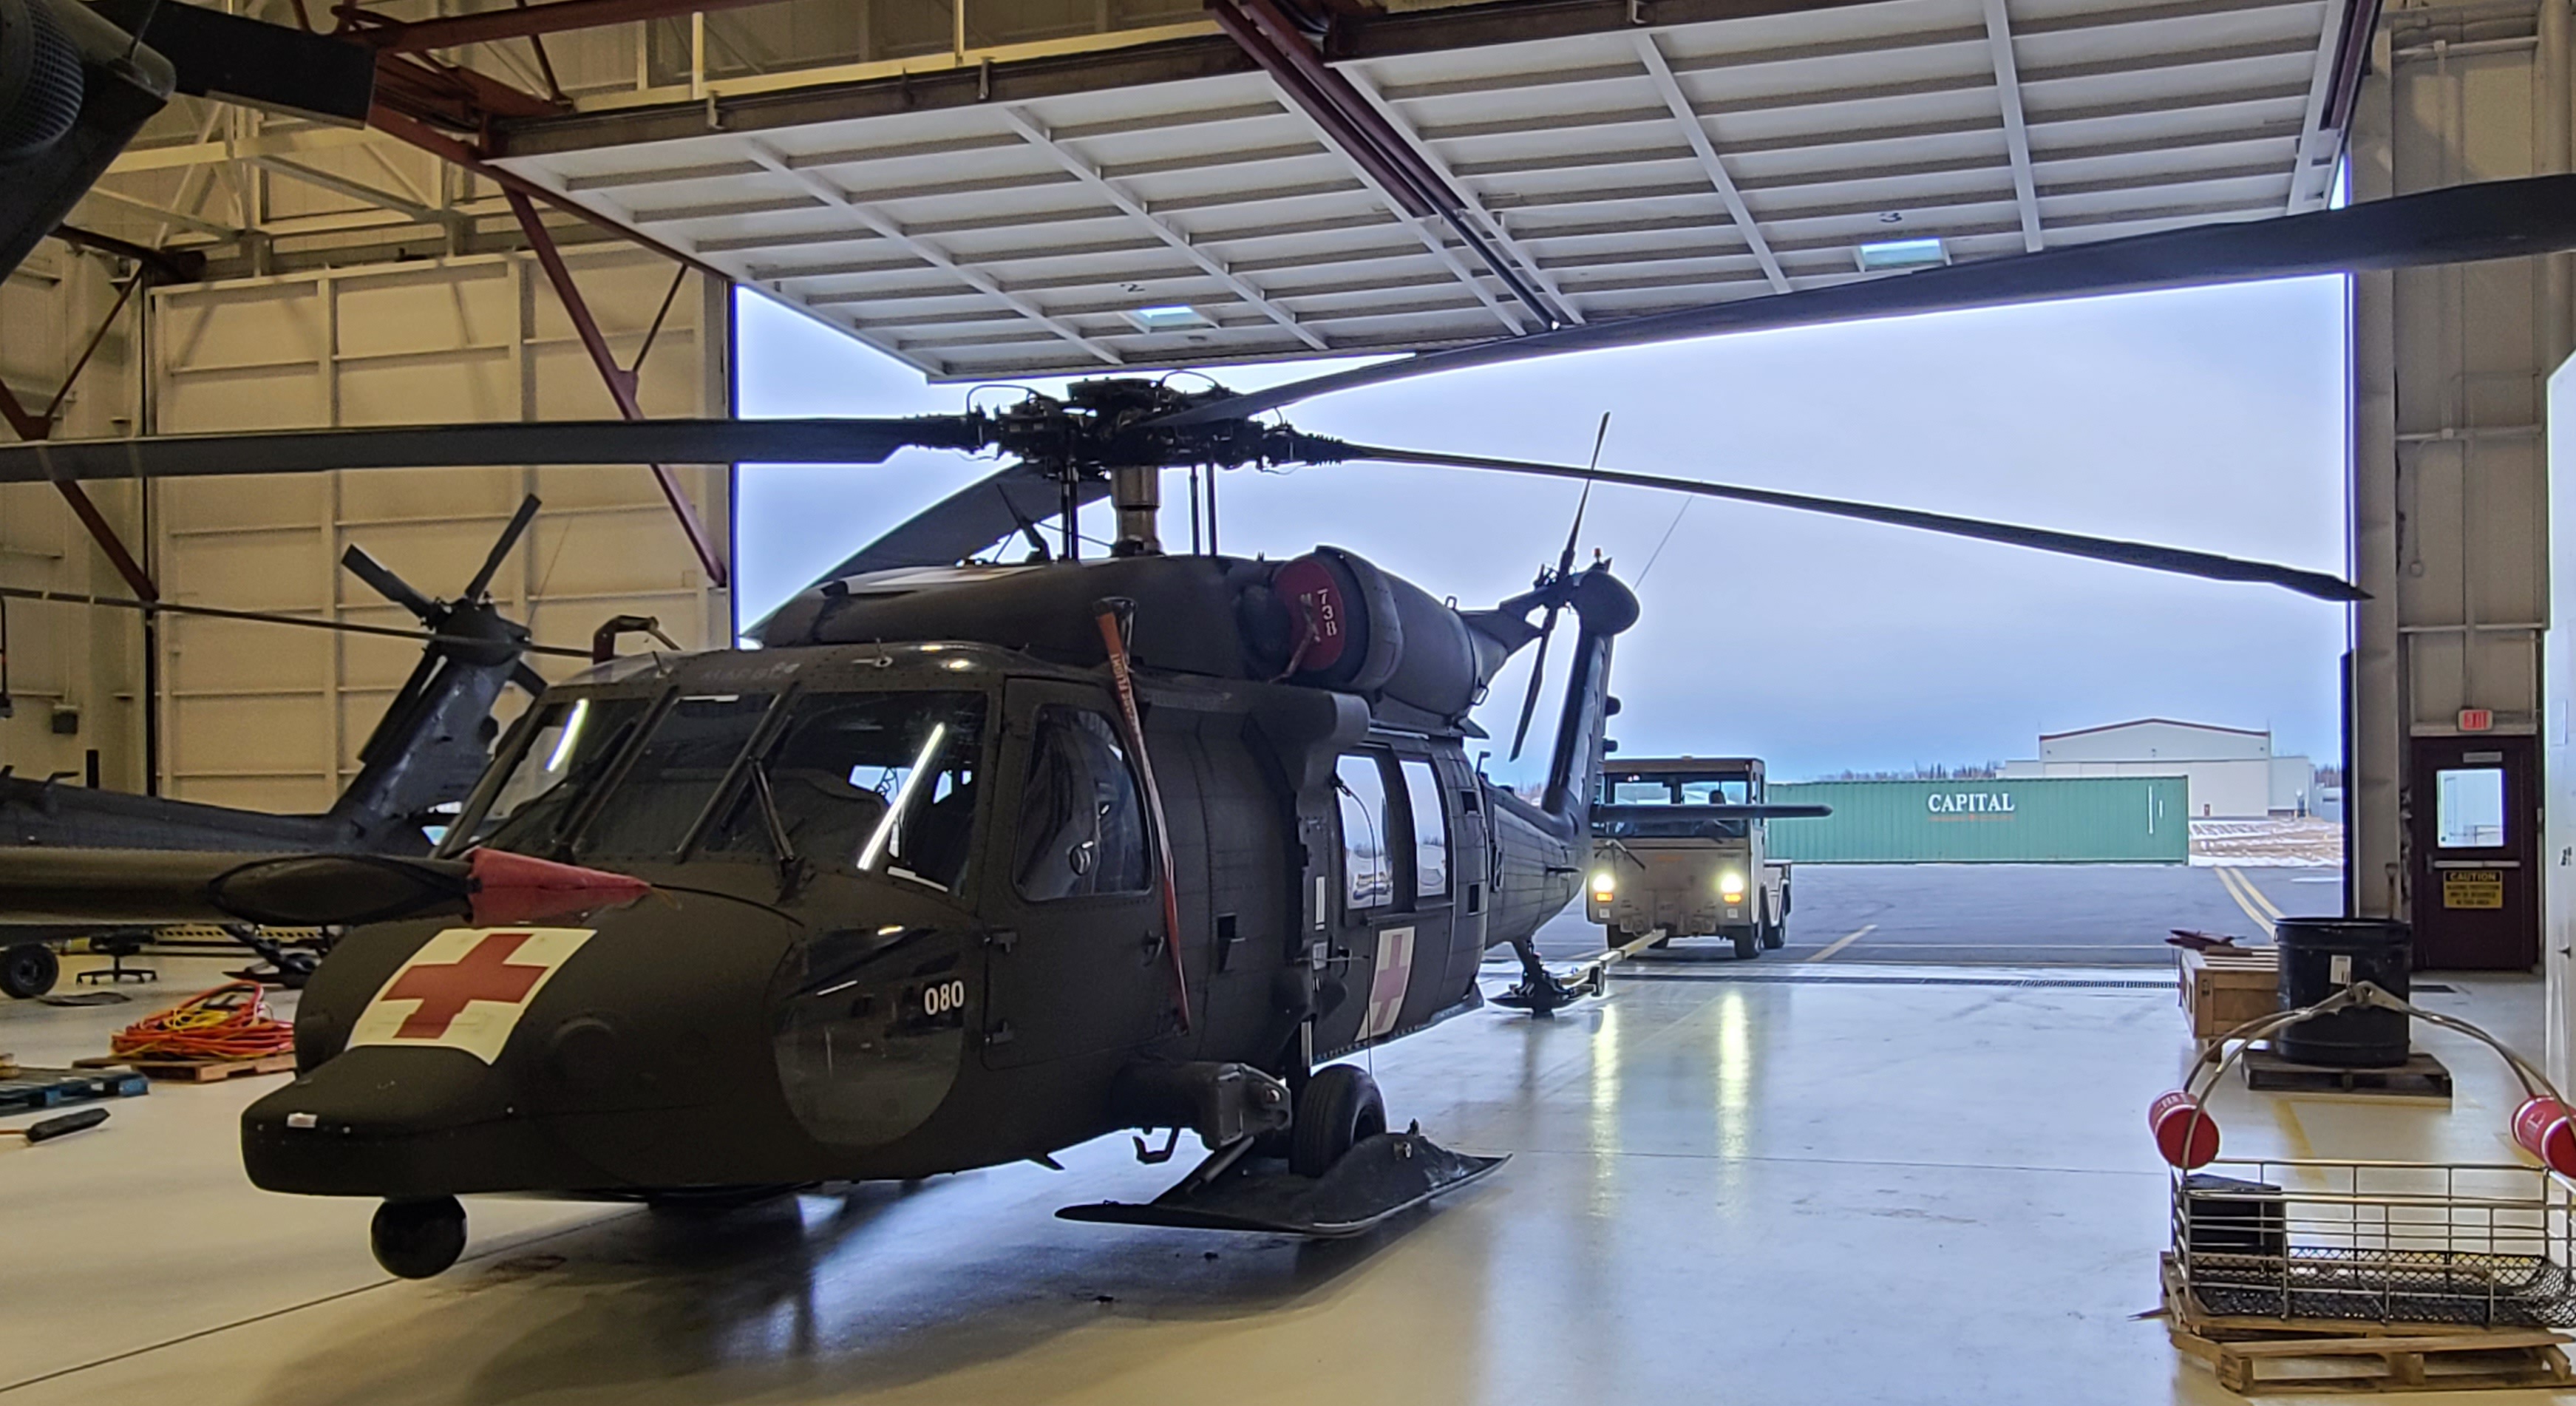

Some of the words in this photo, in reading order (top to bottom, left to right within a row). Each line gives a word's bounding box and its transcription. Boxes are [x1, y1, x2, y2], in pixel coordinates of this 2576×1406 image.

[1316, 588, 1337, 636] 738
[1109, 653, 1129, 692] FLIGHT
[1927, 792, 2016, 812] CAPITAL
[2450, 872, 2497, 882] CAUTION
[924, 980, 965, 1015] 080
